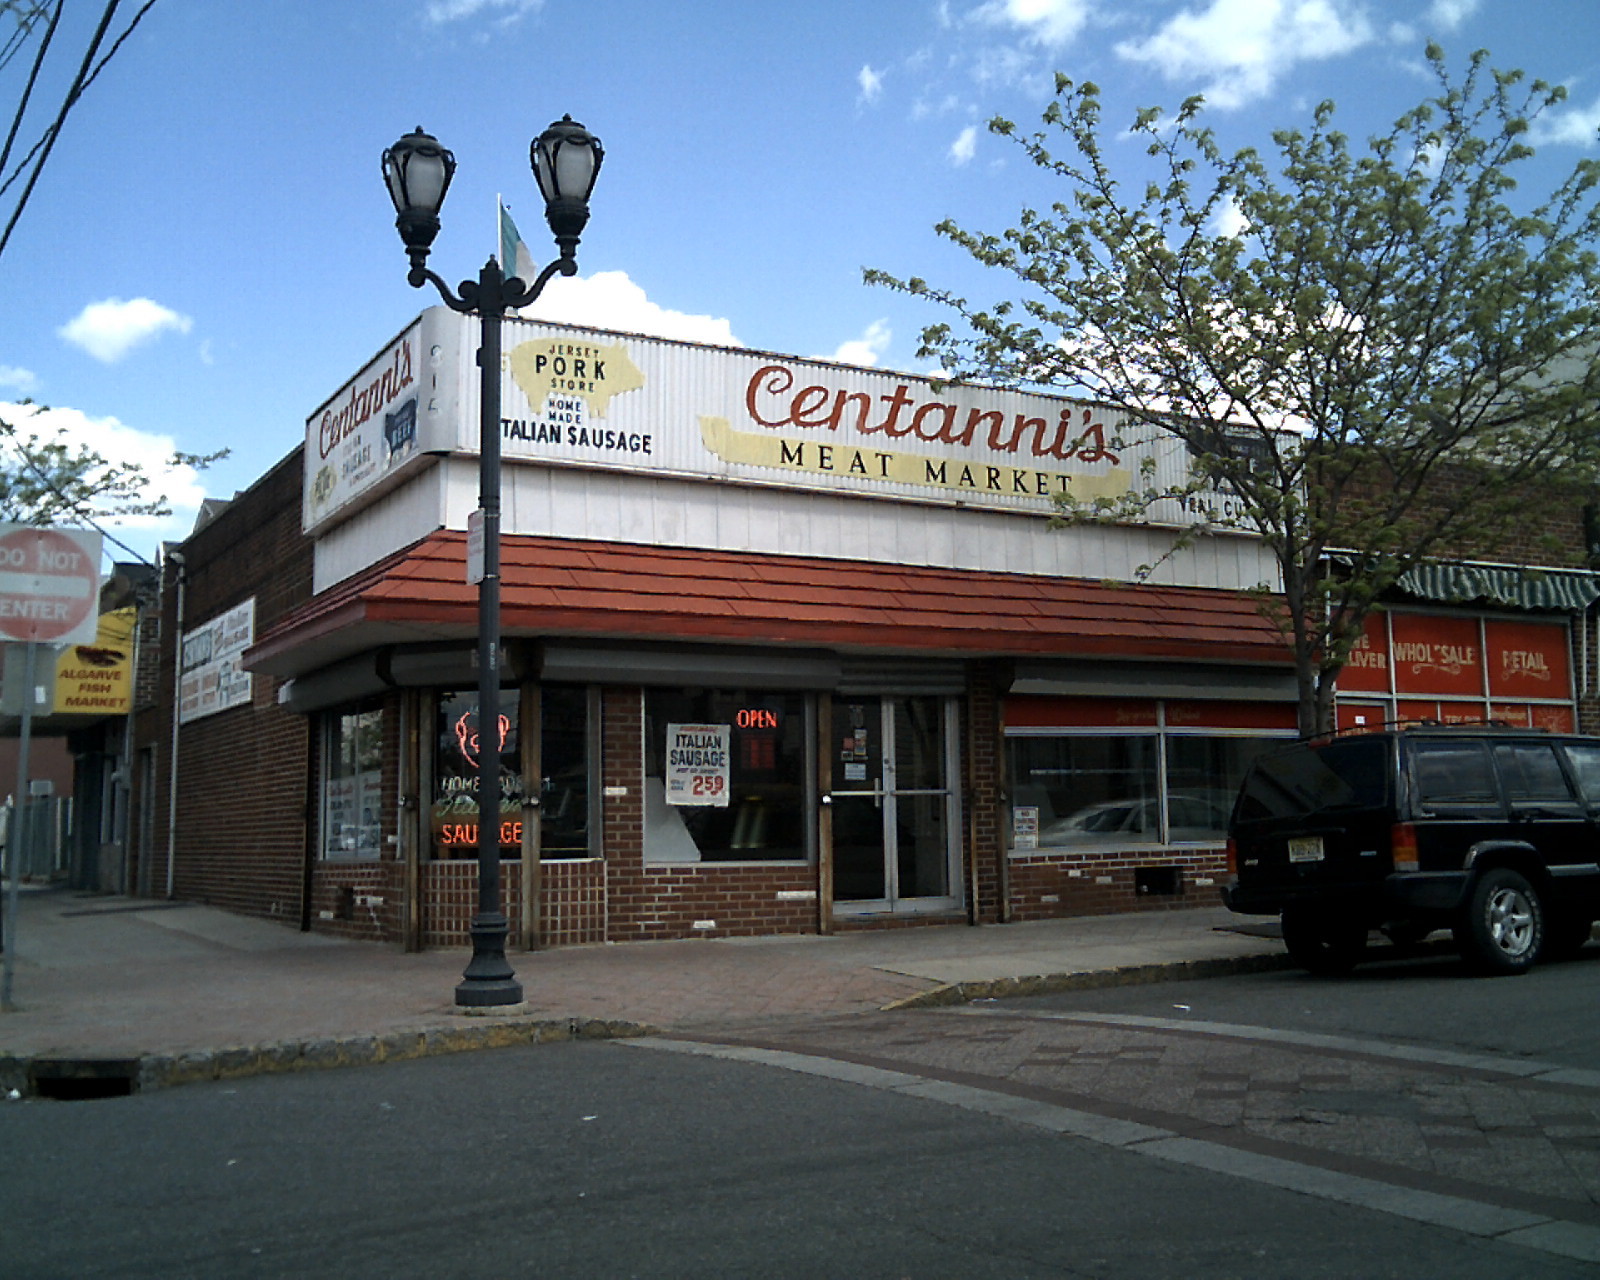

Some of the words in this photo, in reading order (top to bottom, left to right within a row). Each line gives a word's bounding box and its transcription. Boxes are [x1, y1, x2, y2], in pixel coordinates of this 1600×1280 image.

[548, 345, 599, 358] JERSEY
[535, 354, 606, 381] PORK
[551, 377, 595, 393] STORE
[549, 400, 582, 412] HOME
[549, 412, 582, 424] MADE
[746, 365, 1121, 465] Centanni's
[500, 419, 561, 444] TALIAN
[567, 425, 653, 455] SAUSAGE
[780, 440, 893, 478] MEAT
[925, 459, 1072, 496] MARKET
[0, 547, 25, 567] DO
[39, 551, 82, 571] NOT
[1, 600, 69, 620] ENTER
[58, 669, 122, 681] ALGARVE
[78, 683, 112, 694] FISH
[65, 697, 127, 708] MARKET
[736, 709, 777, 728] OPEN
[676, 733, 722, 749] ITALIAN
[670, 749, 726, 767] SAUSAGE
[442, 776, 480, 793] HOME
[441, 822, 523, 844] SAUGE
